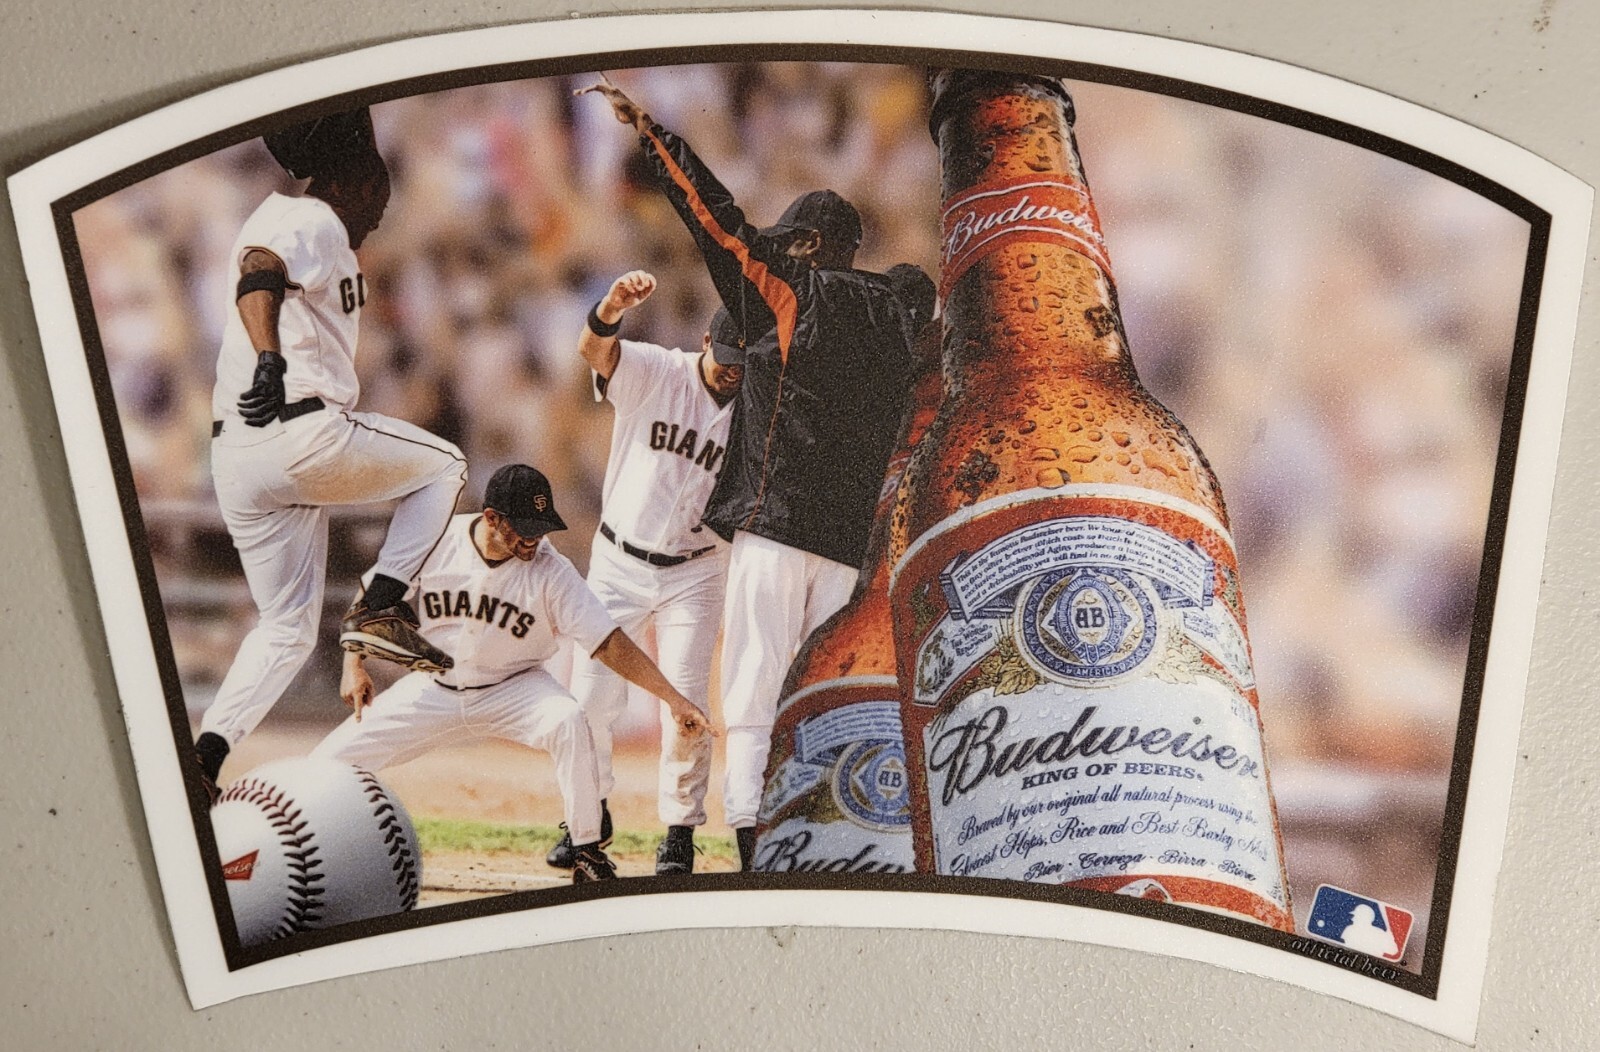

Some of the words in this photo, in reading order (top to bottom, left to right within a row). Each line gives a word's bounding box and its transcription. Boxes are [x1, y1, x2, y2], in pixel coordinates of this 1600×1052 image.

[340, 276, 365, 315] GI
[650, 421, 724, 480] GIAN
[423, 590, 535, 638] GIANTS
[1075, 607, 1105, 629] AB
[929, 705, 1259, 806] Budweiser
[1021, 766, 1079, 791] KING
[1085, 762, 1118, 777] OF
[957, 806, 1008, 846] Brewed
[1006, 803, 1020, 830] by
[1021, 803, 1043, 818] our
[1046, 786, 1101, 816] original
[1100, 784, 1123, 802] all
[1123, 785, 1174, 803] natural
[1169, 791, 1216, 812] process
[1218, 801, 1243, 824] using
[1050, 815, 1097, 844] Rice
[1098, 816, 1131, 836] and
[1131, 811, 1180, 836] Best
[1182, 816, 1235, 851] Barley
[1023, 860, 1064, 881] Bier
[1079, 852, 1147, 871] Cerveza
[1158, 850, 1208, 868] Birra
[1291, 938, 1359, 969] official
[1362, 955, 1402, 981] beer
